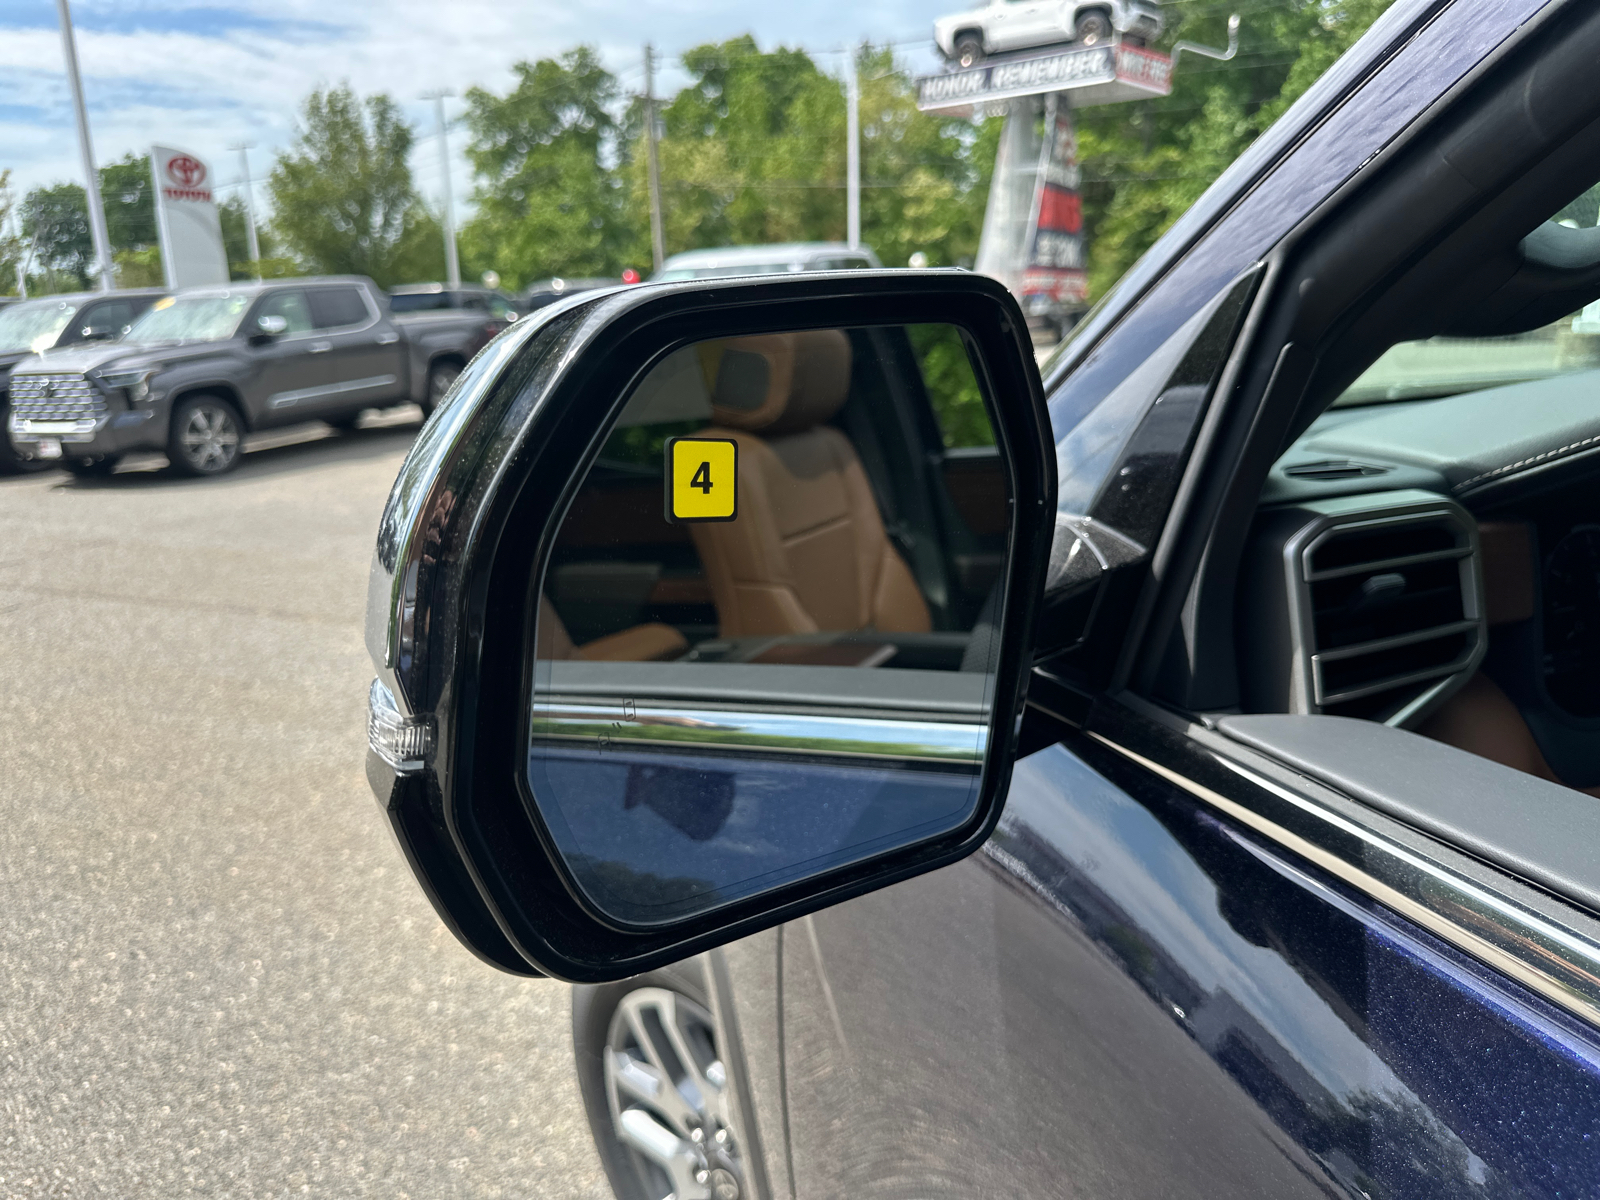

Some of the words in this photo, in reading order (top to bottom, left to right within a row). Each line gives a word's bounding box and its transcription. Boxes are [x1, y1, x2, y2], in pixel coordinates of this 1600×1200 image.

[921, 70, 987, 101] HONOR
[989, 48, 1111, 91] REMEMBER
[690, 461, 713, 494] 4
